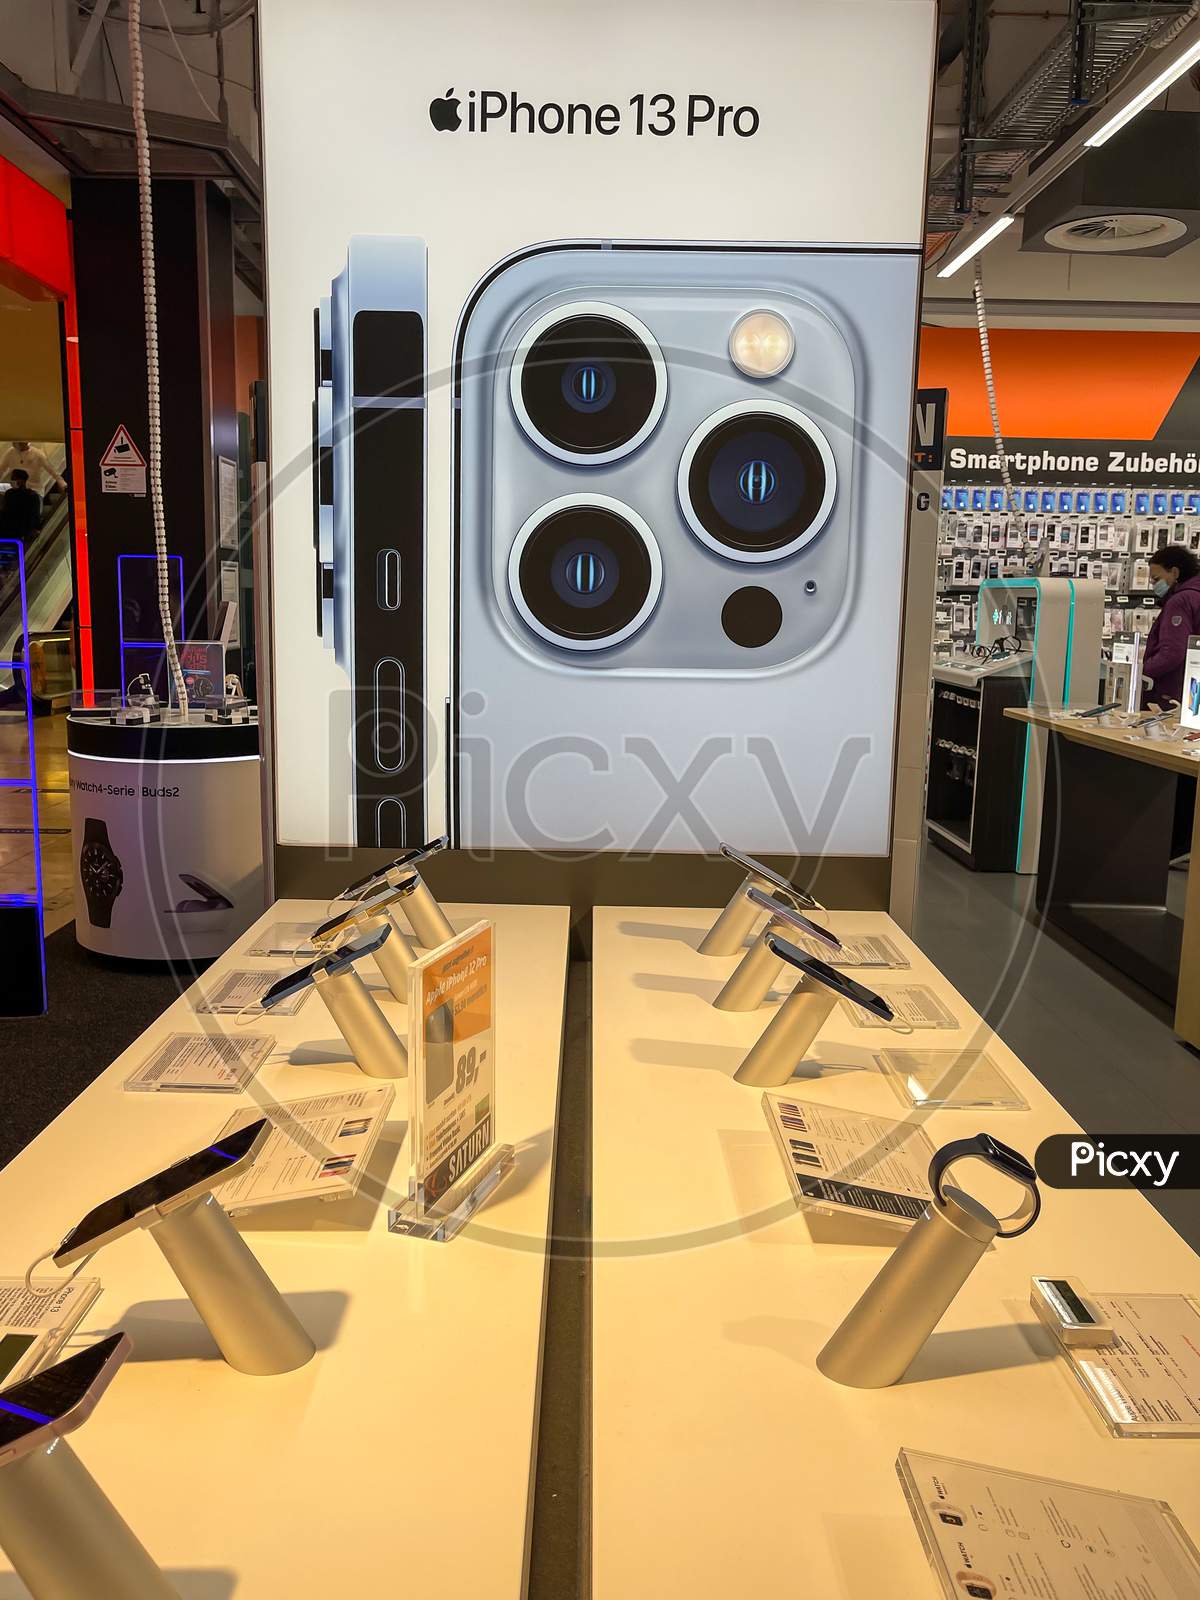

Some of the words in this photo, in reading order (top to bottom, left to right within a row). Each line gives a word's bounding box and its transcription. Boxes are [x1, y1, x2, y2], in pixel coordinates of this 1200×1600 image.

[467, 89, 621, 136] iPhone
[629, 93, 676, 137] 13
[686, 94, 760, 138] Pro
[949, 447, 1099, 476] Smartphone
[1107, 451, 1200, 474] Zubehö
[141, 786, 180, 798] Buds2
[448, 1120, 490, 1183] SATURN
